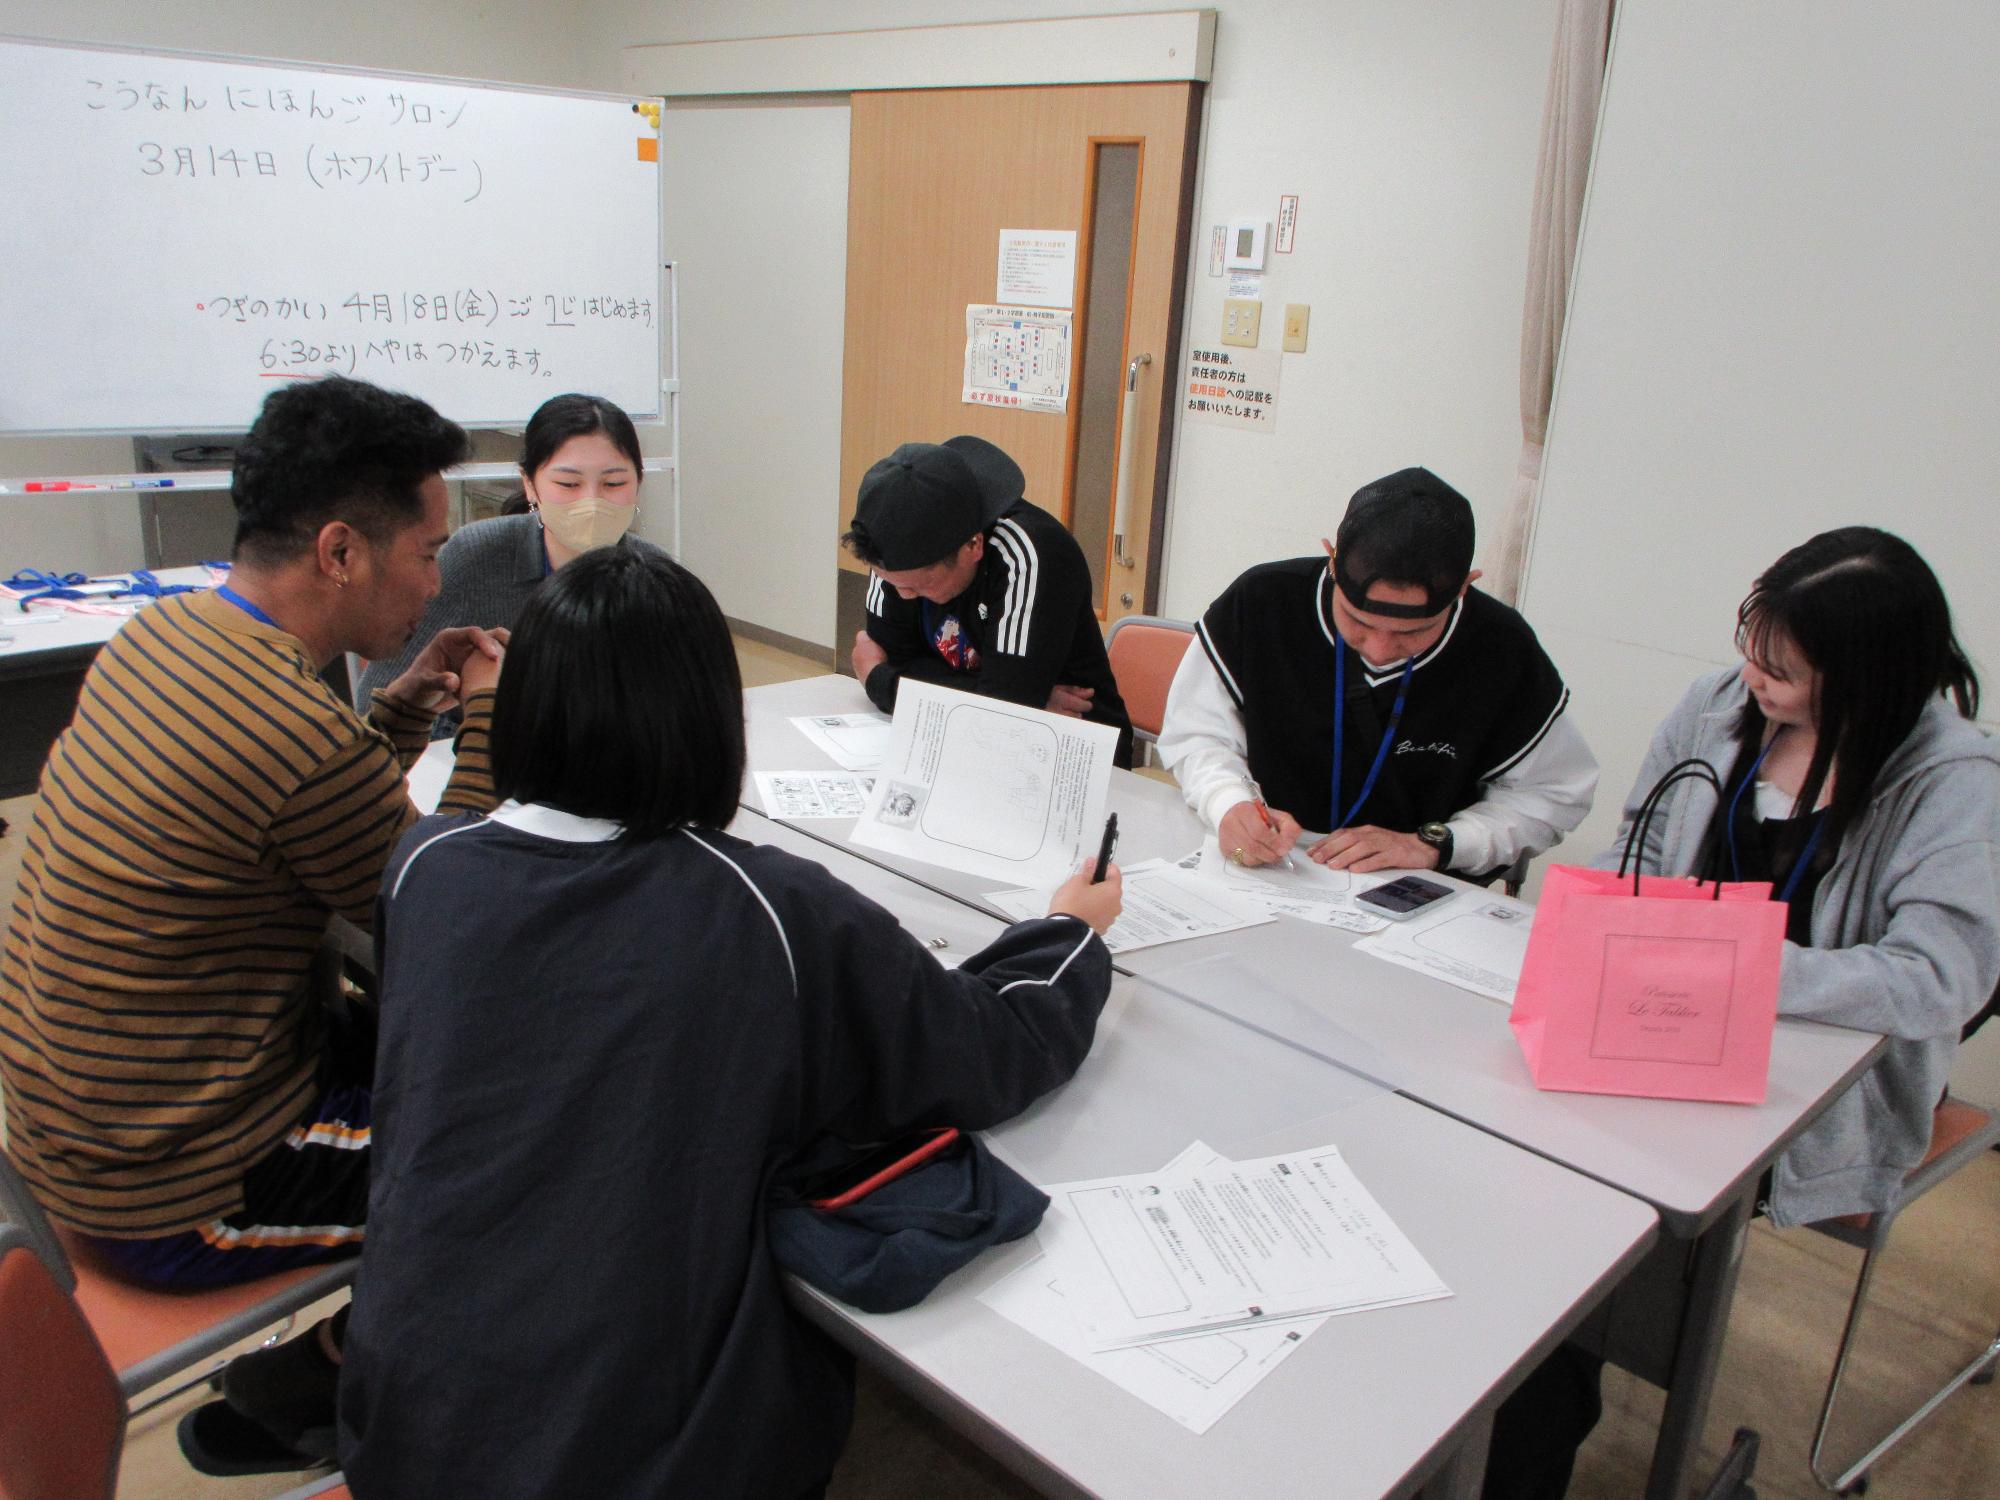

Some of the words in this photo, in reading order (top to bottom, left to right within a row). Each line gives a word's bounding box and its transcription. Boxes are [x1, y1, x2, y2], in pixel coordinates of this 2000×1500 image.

[85, 80, 208, 113] こうなん
[226, 87, 367, 125] にほんご
[137, 142, 277, 178] 3月14日
[1191, 365, 1247, 383] 責任者の方は
[1187, 398, 1266, 421] お願いいたします。
